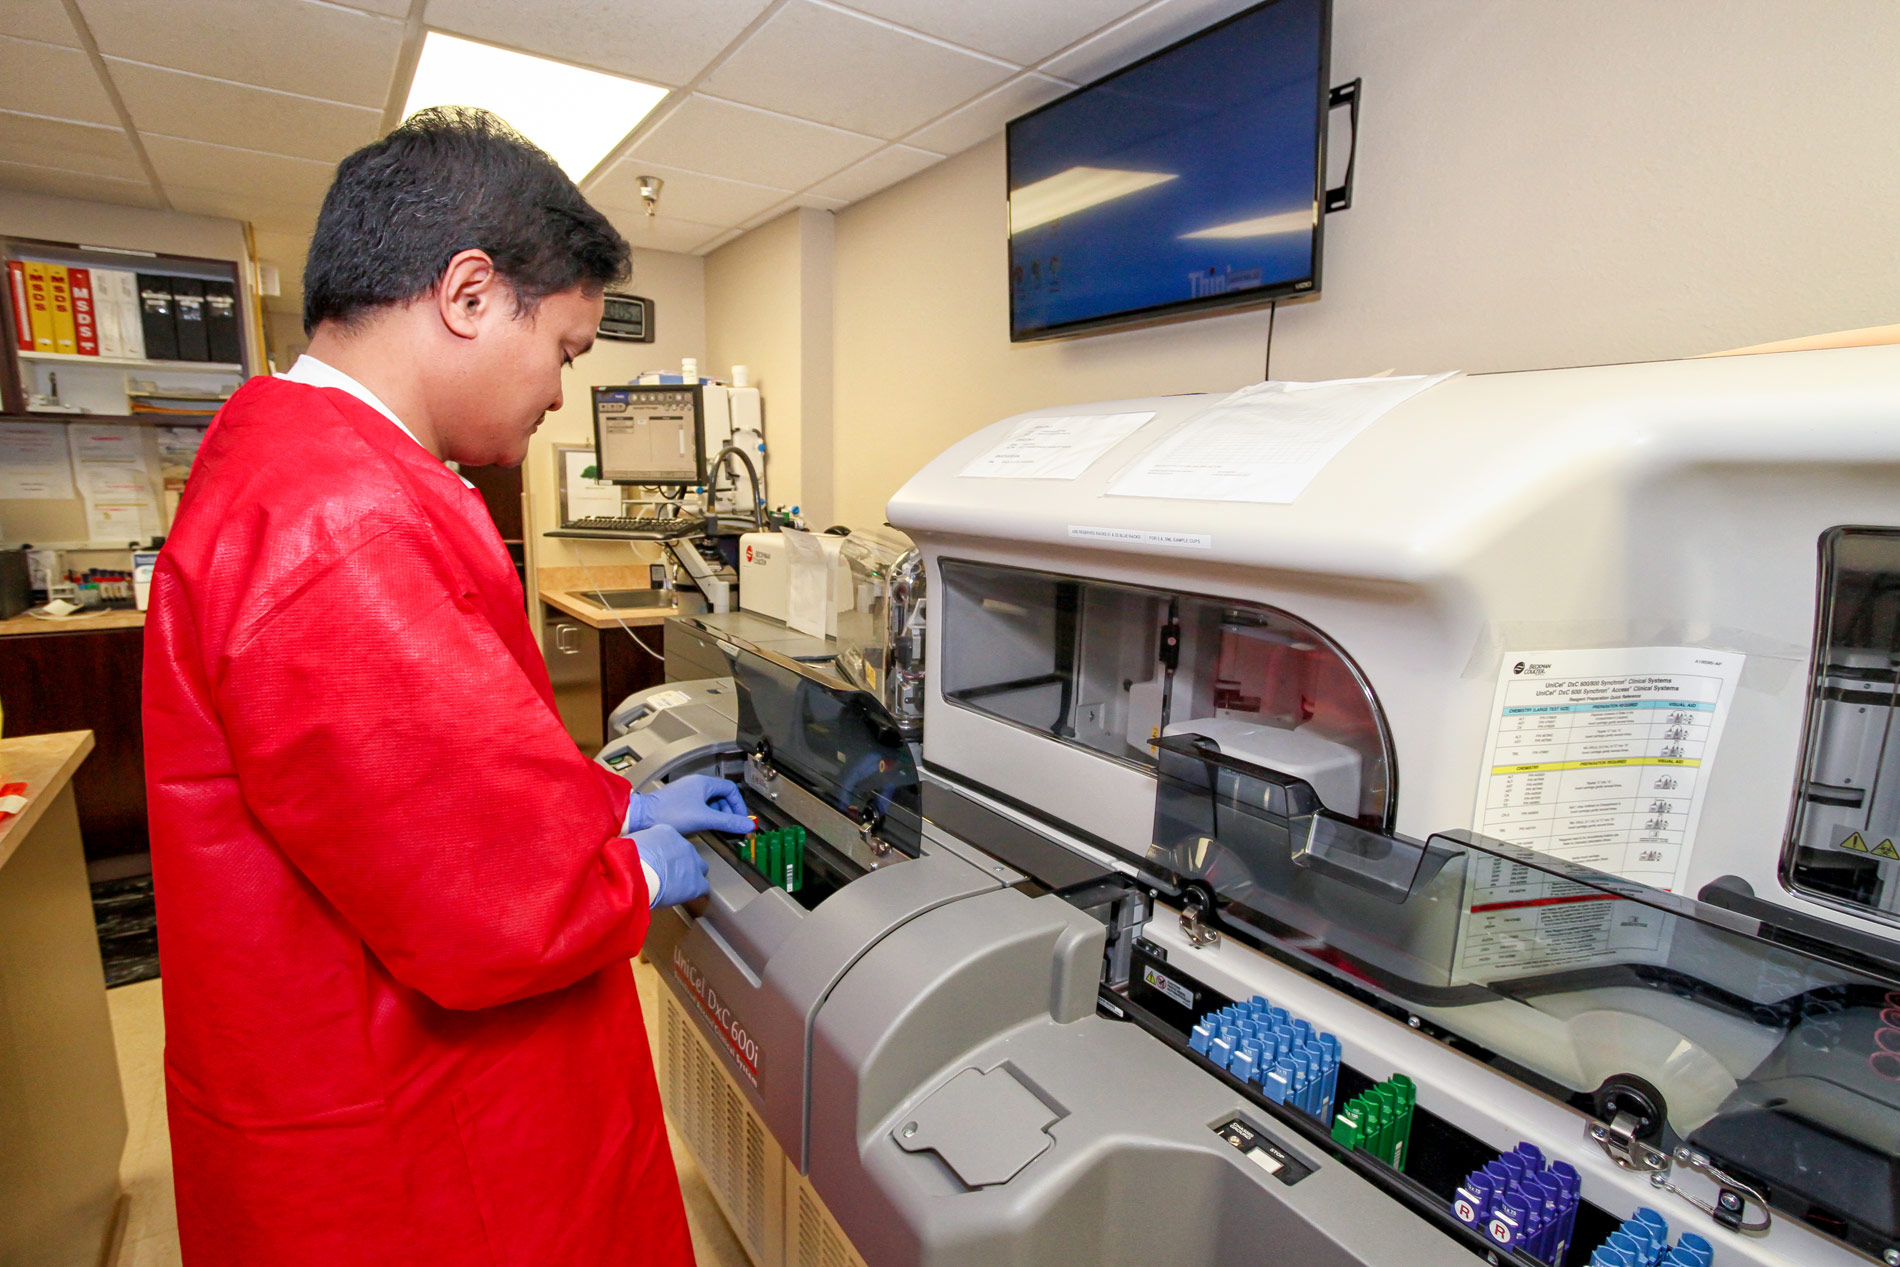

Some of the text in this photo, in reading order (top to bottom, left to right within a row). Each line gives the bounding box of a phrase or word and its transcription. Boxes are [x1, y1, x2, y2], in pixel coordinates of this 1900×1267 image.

[30, 274, 46, 311] MSDS
[1295, 281, 1312, 289] VIZIO
[51, 276, 67, 312] MSDS
[72, 287, 92, 337] MSDS
[674, 945, 706, 998] UniCel
[707, 988, 731, 1030] DxC
[731, 1021, 759, 1069] 600i
[1229, 1124, 1253, 1140] GROUND
[1269, 1147, 1285, 1159] STOP
[1460, 1204, 1470, 1218] R
[1495, 1224, 1505, 1239] R
